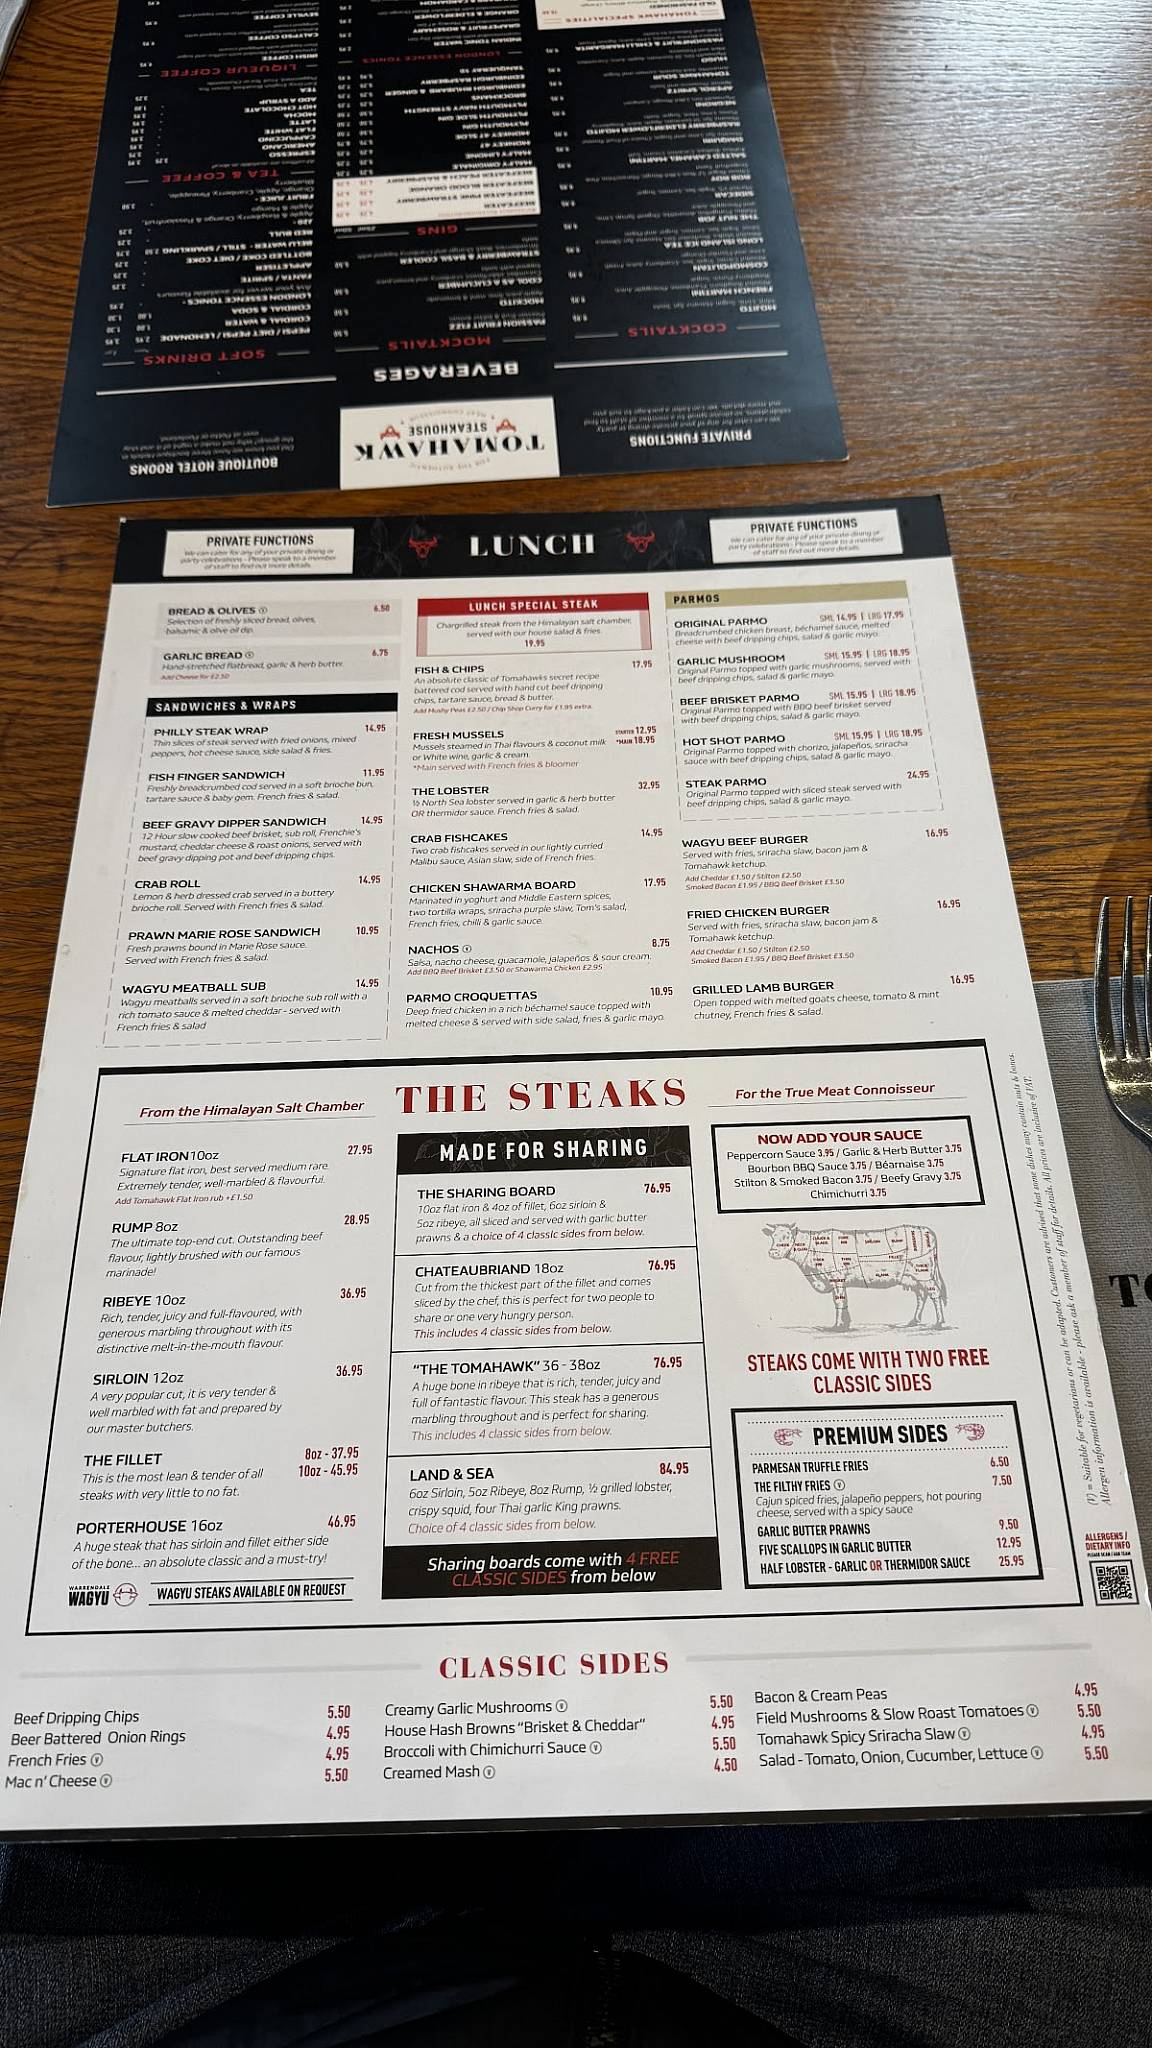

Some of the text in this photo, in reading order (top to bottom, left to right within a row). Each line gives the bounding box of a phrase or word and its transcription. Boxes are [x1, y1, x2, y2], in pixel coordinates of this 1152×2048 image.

[160, 64, 296, 77] LIQUEUR COFFEE
[162, 172, 224, 182] COFFEE
[248, 169, 278, 177] TEA
[416, 225, 457, 235] GINS
[628, 323, 726, 336] COCKTAILS
[388, 336, 490, 350] MOCKTAILS
[144, 350, 264, 365] SOFT DRINKS
[374, 362, 518, 381] BEVERAGES
[409, 422, 487, 436] STEAKHOUSE
[630, 429, 752, 447] PRIVATE FUNCTIONS
[355, 435, 544, 459] TOMAHAWK
[130, 457, 278, 475] BOUTIQUE HOTEL ROOMS
[750, 518, 857, 533] PRIVATE FUNCTIONS
[206, 535, 313, 546] PRIVATE FUNCTIONS
[470, 534, 594, 555] LUNCH
[469, 599, 597, 611] LUNCH SPECIAL STEAK
[674, 594, 719, 604] PARMOS
[525, 639, 544, 647] 19.95
[163, 652, 202, 660] GARLIC
[415, 666, 439, 674] FISH
[452, 665, 484, 673] CHIPS
[632, 660, 652, 668] 17.95
[155, 700, 296, 711] SANDWICHES & WRAPS
[365, 724, 385, 732] 14.95
[907, 770, 929, 779] 24.95
[412, 786, 488, 795] THE LOBSTER
[638, 781, 659, 789] 32.95
[926, 828, 948, 837] 16.95
[682, 835, 808, 847] WAGYU BEEF BURGER
[534, 854, 543, 862] of
[684, 861, 729, 869] Tomahawk
[134, 880, 200, 888] CRAB ROLL
[359, 875, 380, 883] 14.95
[652, 938, 669, 947] 8.75
[408, 945, 458, 954] NACHOS
[122, 982, 266, 993] WAGYU MEATBALL SUB
[650, 986, 672, 996] 10.95
[692, 981, 834, 994] GRILLED LAMB BURGER
[406, 991, 537, 1002] PARMO CROQUETTAS
[694, 1007, 823, 1020] chutney, French fries & salad.
[396, 1079, 685, 1113] THE STEAKS
[736, 1084, 935, 1099] For the True Meat Connoisseur
[140, 1101, 364, 1117] From the Himalayan Salt Chamber
[758, 1130, 922, 1144] NOW ADD YOUR SAUCE
[440, 1139, 646, 1161] MADE FOR SHARING
[810, 1188, 886, 1198] Chimichurri 3.75
[415, 1263, 563, 1277] CHATEAUBRIAND 18oz
[648, 1259, 675, 1270] 76.95
[748, 1348, 989, 1371] STEAKS COME WITH TWO FREE
[336, 1364, 362, 1376] 36.95
[93, 1372, 184, 1385] SIRLOIN 12oz
[814, 1373, 931, 1393] CLASSIC SIDES
[1071, 1379, 1084, 1427] vegetarians
[813, 1424, 947, 1445] PREMIUM SIDES
[1076, 1430, 1088, 1444] for
[1077, 1356, 1111, 1505] Allergen information is available
[752, 1460, 868, 1473] PARMESAN TRUFFLE FRIES
[990, 1456, 1009, 1467] 6.50
[1078, 1445, 1092, 1481] Suitable
[76, 1519, 222, 1534] PORTERHOUSE 16oz
[328, 1515, 356, 1527] 46.95
[1085, 1532, 1124, 1541] ALLERGENS
[1085, 1541, 1131, 1550] DIETARY INFO
[157, 1583, 346, 1600] WAGYU STEAKS AVAILABLE ON REQUEST
[69, 1591, 110, 1606] WAGYU
[440, 1652, 668, 1678] CLASSIC SIDES
[754, 1688, 887, 1703] Bacon & Cream Peas
[1074, 1682, 1097, 1696] 4.95
[14, 1710, 139, 1726] Beef Dripping Chips
[328, 1705, 350, 1718] 5.50
[11, 1730, 186, 1745] Beer Battered Onion Rings
[757, 1728, 955, 1745] Tomahawk Spicy Sriracha Slaw
[326, 1746, 348, 1760] 4.95
